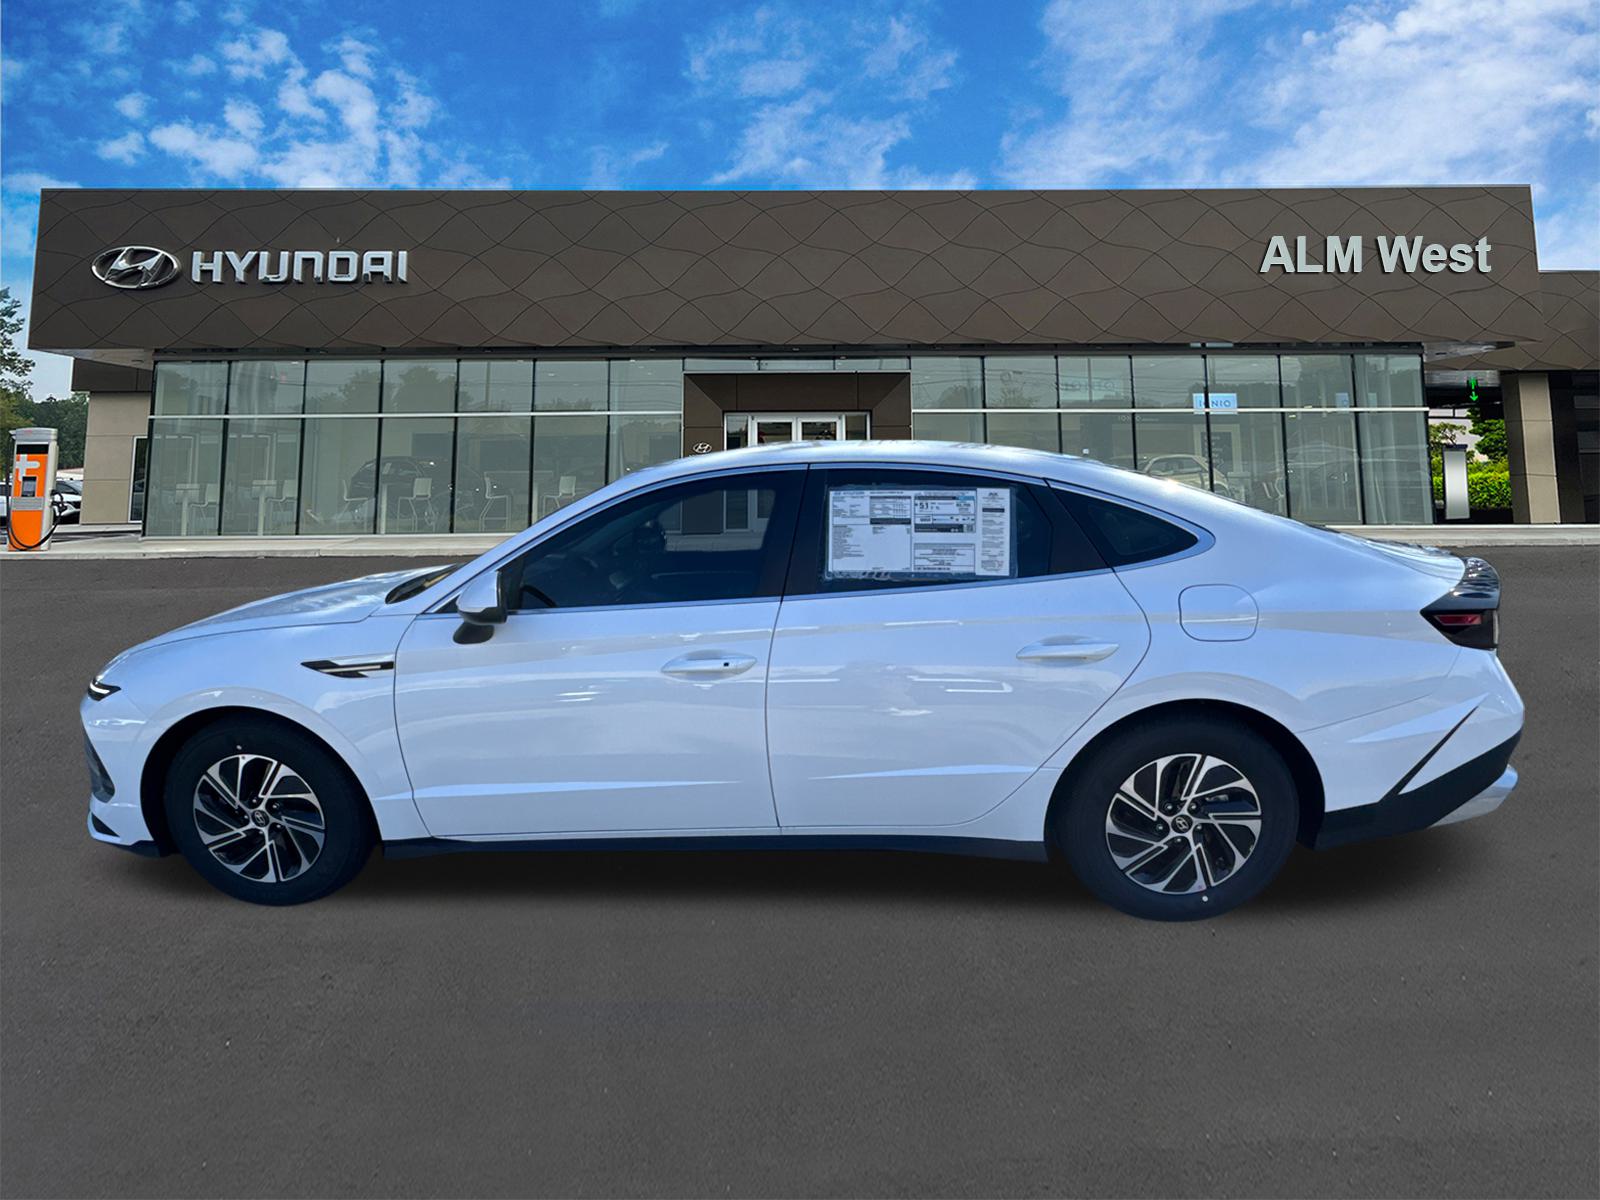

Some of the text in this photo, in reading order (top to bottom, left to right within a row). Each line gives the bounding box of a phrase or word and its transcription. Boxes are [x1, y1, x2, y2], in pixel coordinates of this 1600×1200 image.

[191, 250, 408, 283] HYUNDAI
[1260, 235, 1492, 273] ALM West
